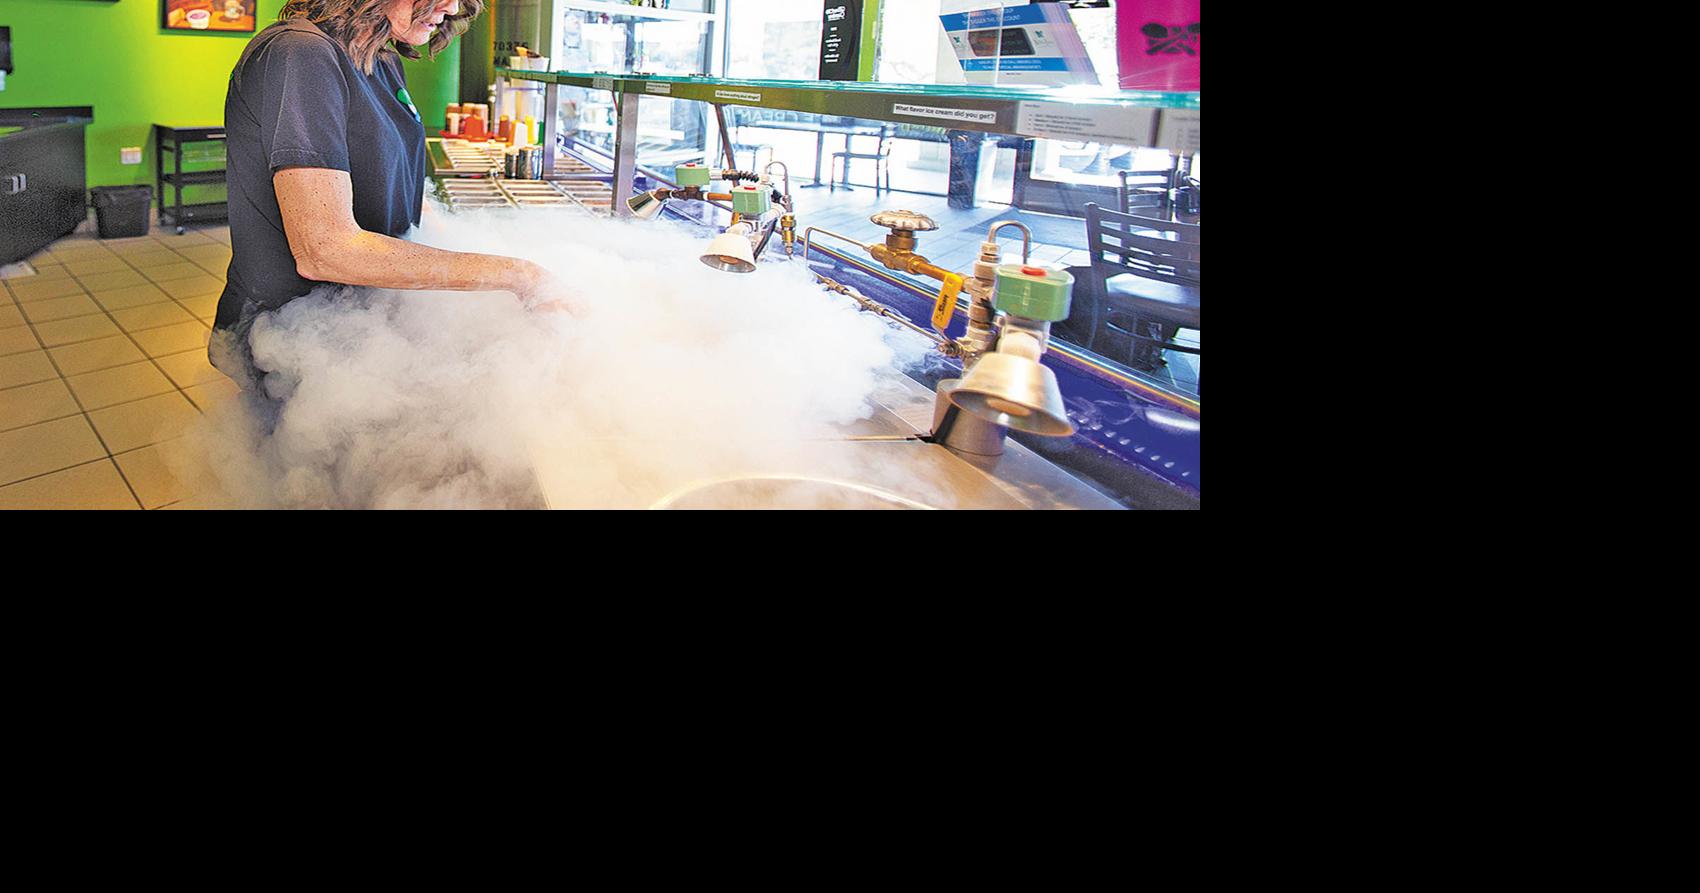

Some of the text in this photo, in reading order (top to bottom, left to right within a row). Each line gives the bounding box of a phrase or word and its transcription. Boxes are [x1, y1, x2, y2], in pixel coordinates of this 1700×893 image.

[909, 106, 925, 114] flavor
[934, 109, 954, 117] cream
[965, 112, 978, 120] you
[979, 113, 995, 121] get?
